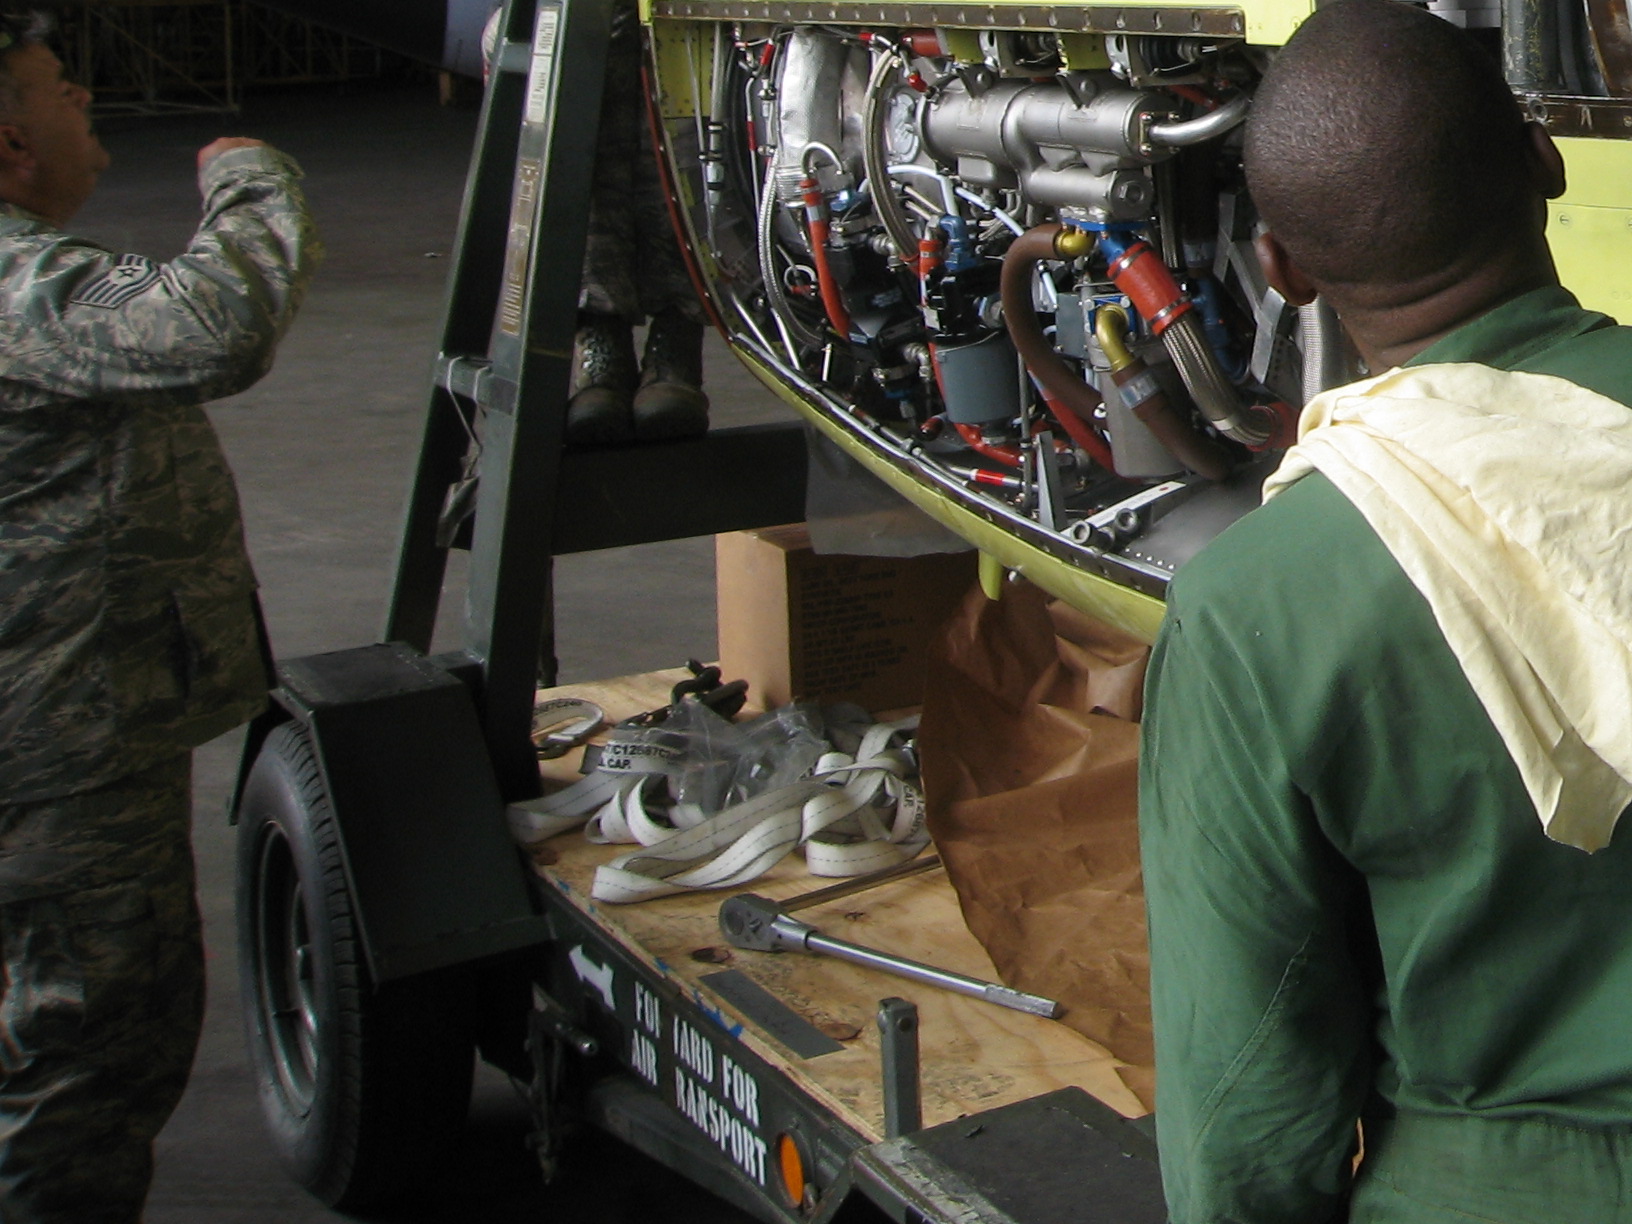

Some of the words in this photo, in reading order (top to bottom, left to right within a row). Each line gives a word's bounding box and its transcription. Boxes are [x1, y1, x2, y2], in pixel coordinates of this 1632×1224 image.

[608, 758, 632, 770] CAP.
[631, 1028, 659, 1087] AIR
[674, 1066, 768, 1187] RANSPORT
[721, 1054, 760, 1128] FOR
